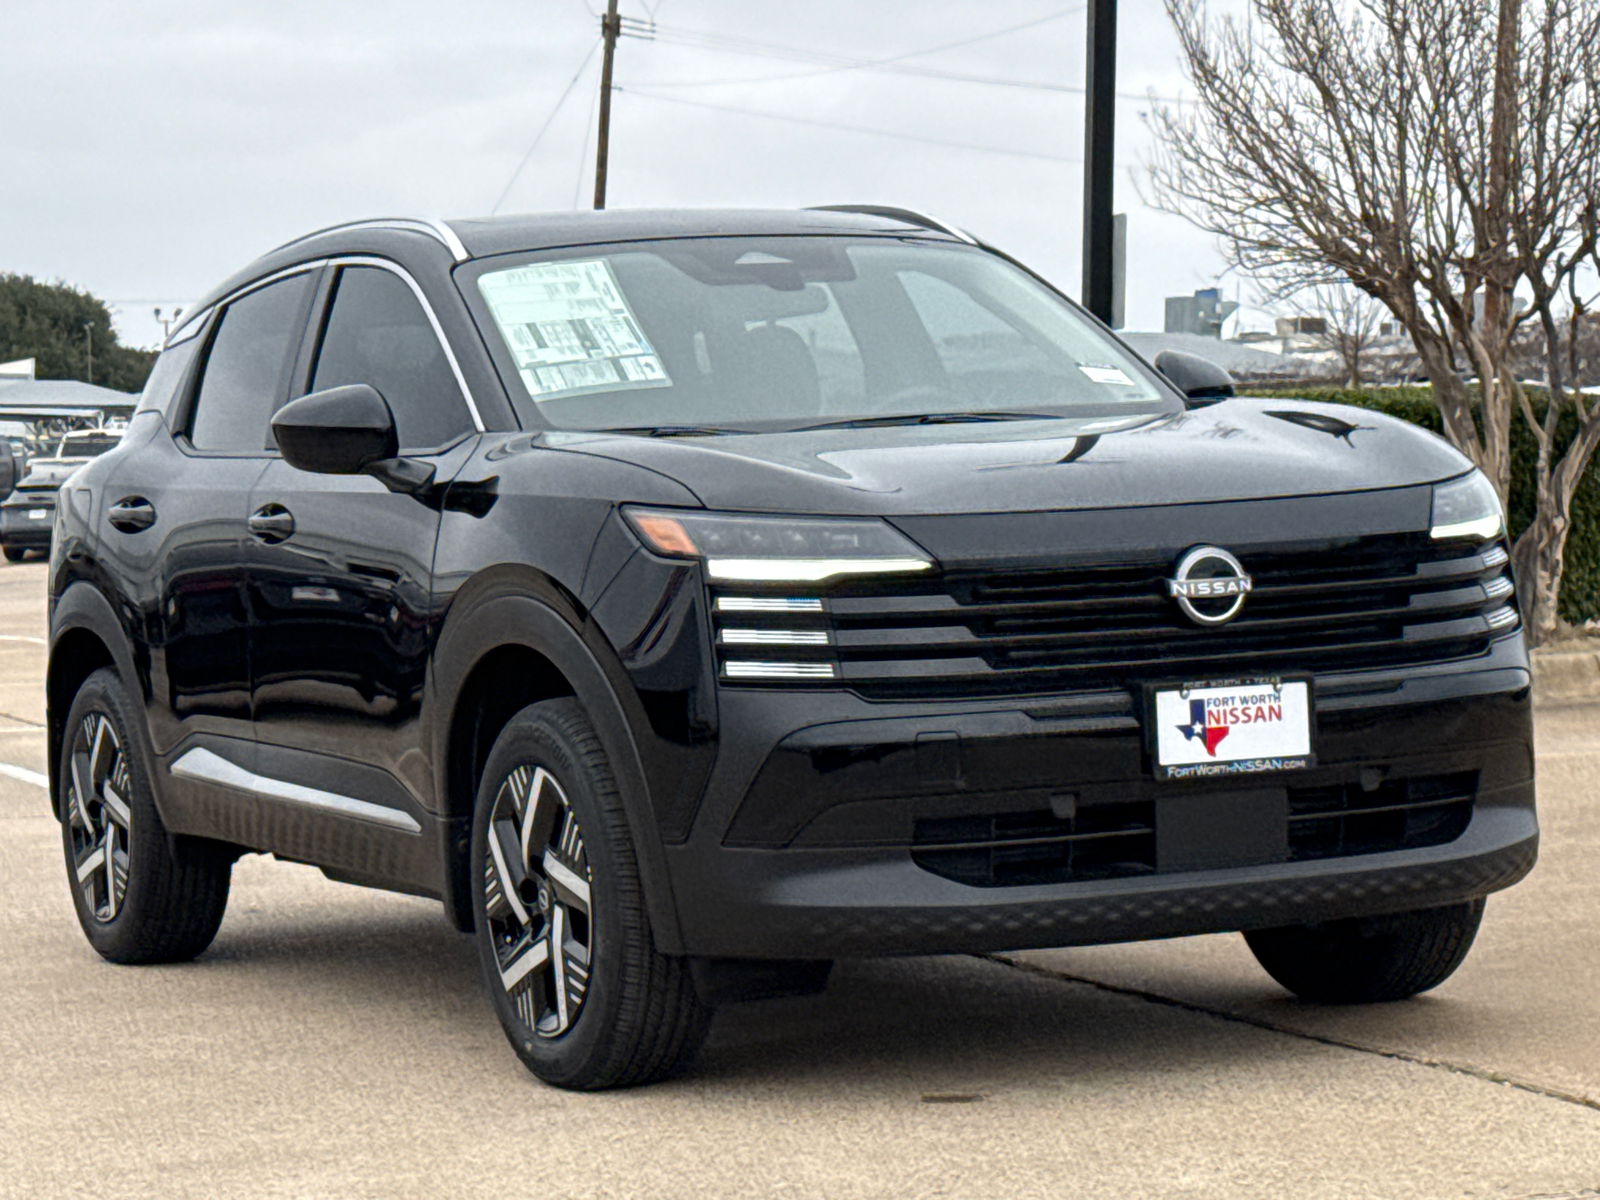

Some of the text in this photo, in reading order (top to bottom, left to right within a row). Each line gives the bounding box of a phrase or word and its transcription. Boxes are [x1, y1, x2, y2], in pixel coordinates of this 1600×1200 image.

[1172, 580, 1251, 595] NISSAN
[1207, 693, 1281, 708] FORT WORTH
[1207, 704, 1282, 725] NISSAN
